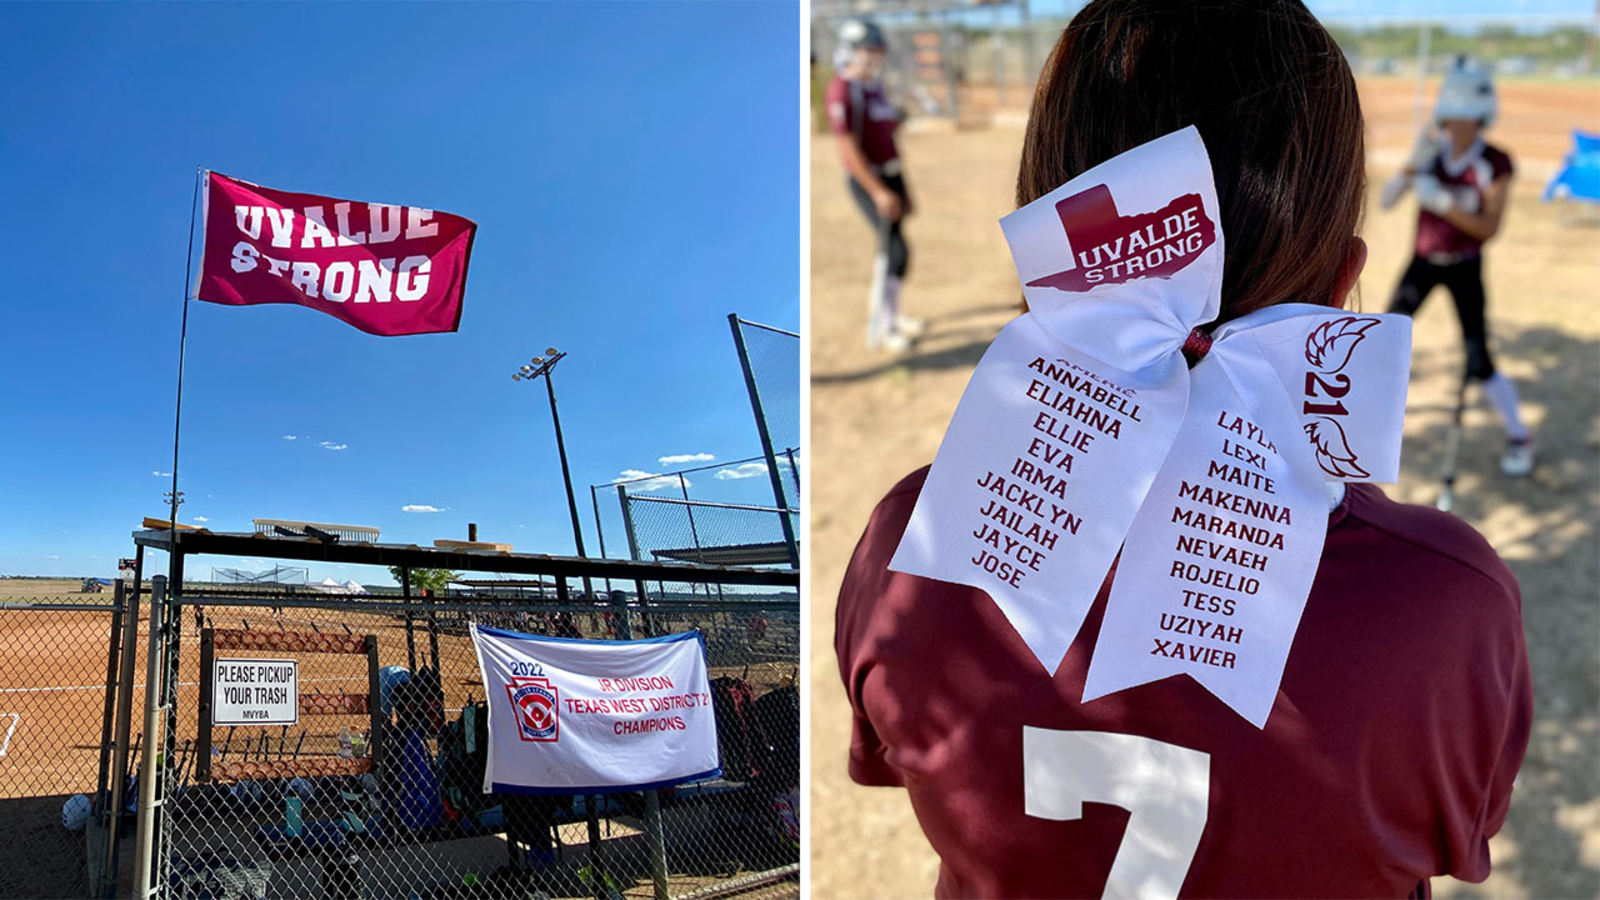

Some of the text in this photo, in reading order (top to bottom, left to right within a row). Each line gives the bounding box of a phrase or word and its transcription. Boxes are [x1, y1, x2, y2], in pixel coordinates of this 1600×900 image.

[234, 202, 438, 248] UVALDE
[1079, 206, 1200, 268] UVALDE
[231, 241, 431, 303] STRONG
[1085, 232, 1203, 283] STRONG
[1028, 357, 1142, 422] ANNABELL
[1303, 371, 1351, 416] 21
[1026, 379, 1122, 440] ELIAHNA
[1033, 411, 1095, 454] ELLIE
[1027, 437, 1074, 474] EVA
[1222, 439, 1266, 471] LEXI
[1011, 457, 1068, 500] IRMA
[1207, 460, 1276, 494] MAITE
[977, 471, 1082, 535] JACKLYN
[1178, 480, 1291, 525] MAKENNA
[980, 500, 1059, 551] JAILAH
[1171, 506, 1284, 550] MARANDA
[973, 524, 1046, 572] JAYCE
[1176, 535, 1268, 571] NEVAEH
[971, 550, 1026, 589] JOSE
[1170, 560, 1260, 595] ROJELIO
[1182, 590, 1237, 616] TESS
[1160, 613, 1244, 644] UZIYAH
[511, 662, 545, 677] 2022
[1150, 639, 1237, 669] XAVIER
[218, 665, 293, 683] PLEASE PICKUP
[598, 676, 674, 693] JR DIVISION
[224, 687, 287, 704] YOUR TRASH
[243, 710, 269, 719] MVYBA
[565, 699, 610, 714] TEXAS
[609, 699, 649, 713] WEST
[649, 693, 700, 711] DISTRICT
[614, 716, 686, 735] CHAMPIONS
[1023, 725, 1210, 900] 7
